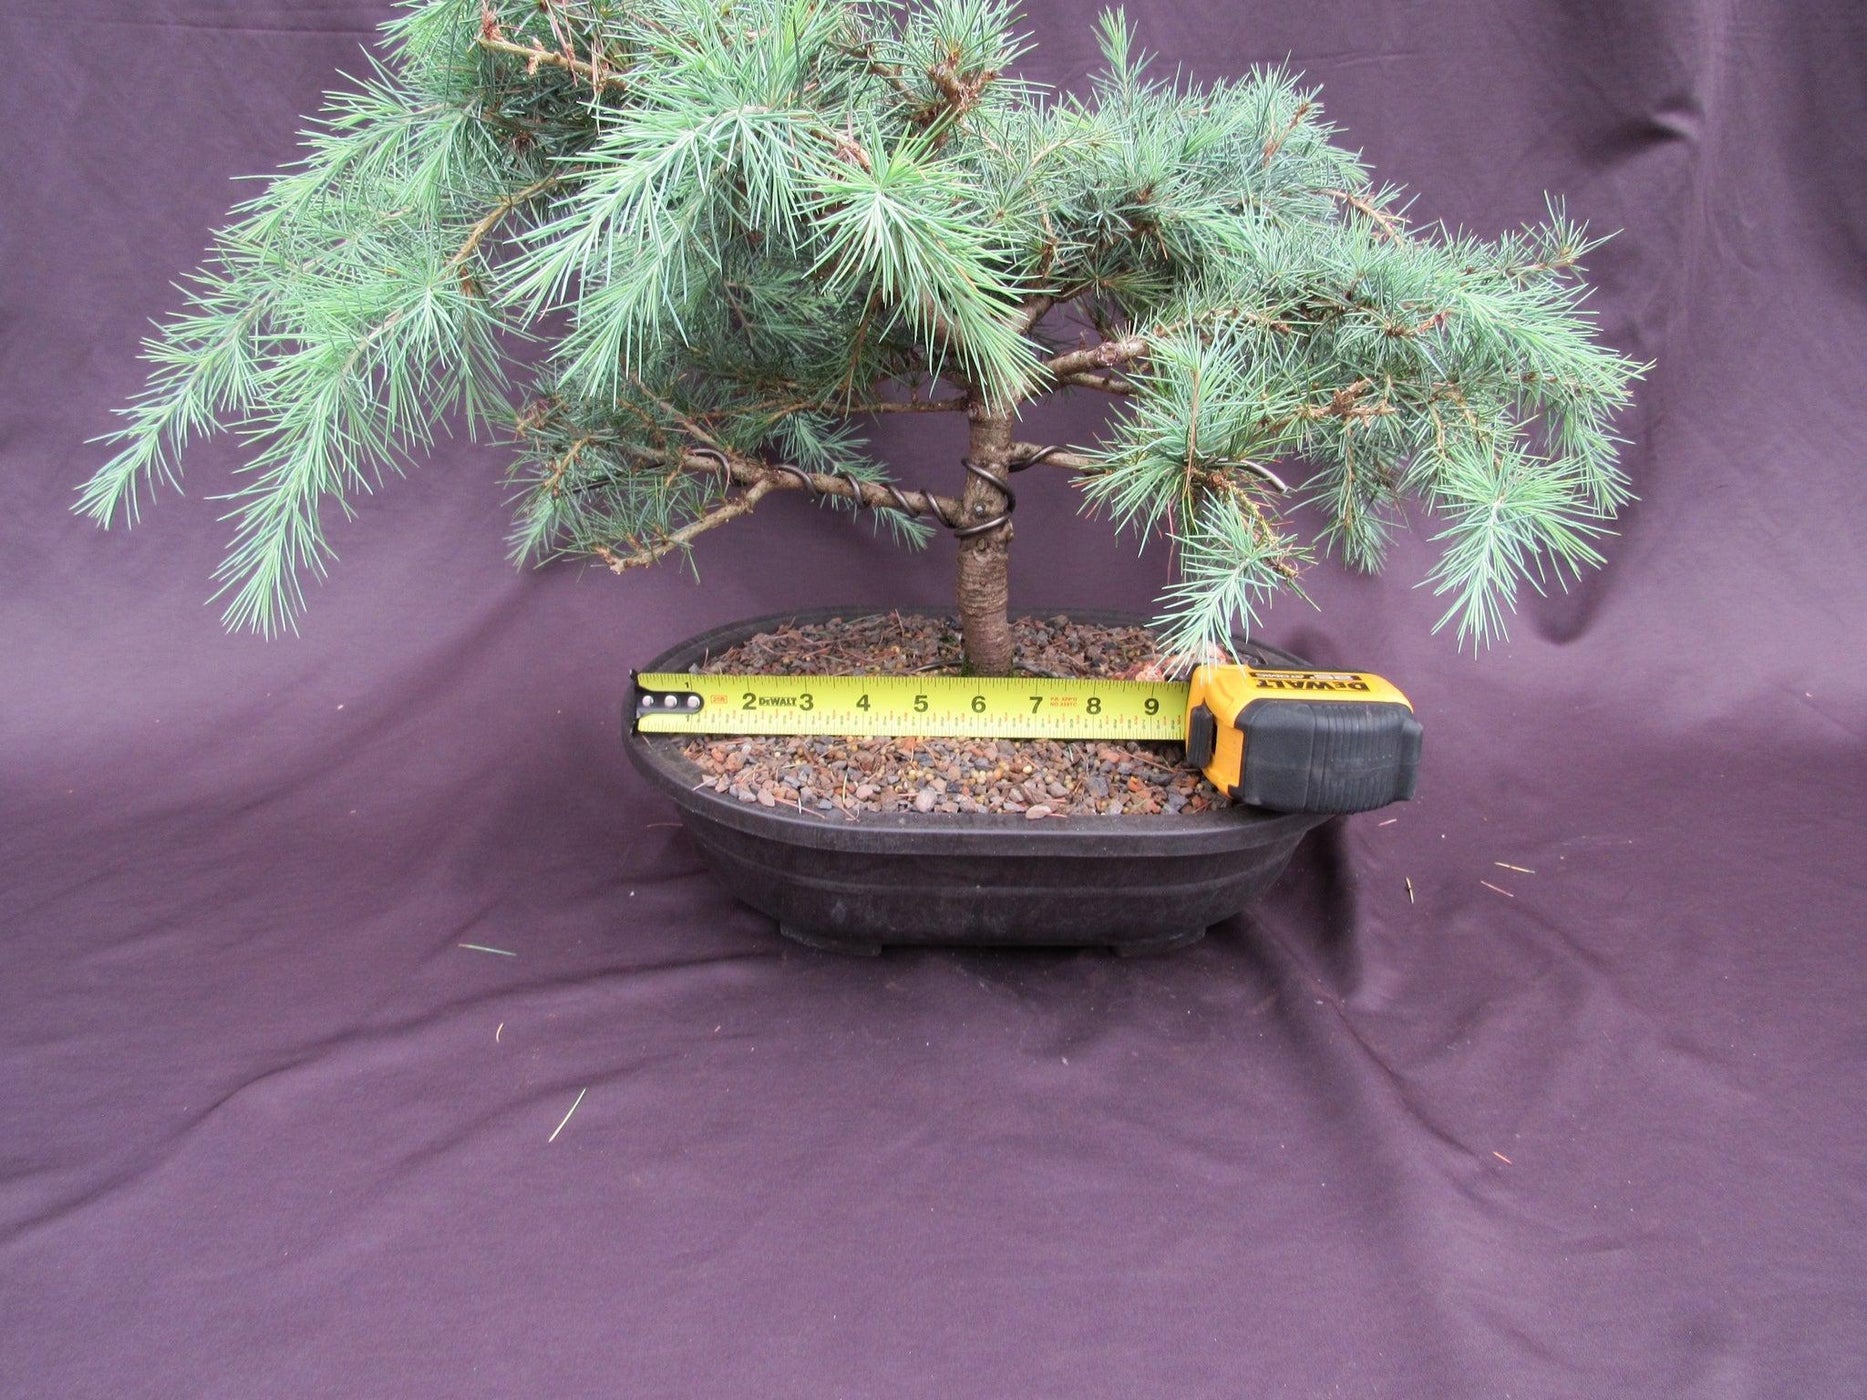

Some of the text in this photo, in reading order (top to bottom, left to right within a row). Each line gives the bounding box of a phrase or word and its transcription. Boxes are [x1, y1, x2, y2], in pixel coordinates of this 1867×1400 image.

[1256, 679, 1370, 692] DEWALT
[742, 692, 757, 710] 2
[758, 696, 798, 706] DEWALT
[799, 693, 814, 711] 3
[856, 694, 871, 712] 4
[913, 695, 929, 713] 5
[971, 695, 986, 713] 6
[1029, 696, 1043, 714] 7
[1086, 697, 1101, 715] 8
[1144, 698, 1159, 716] 9
